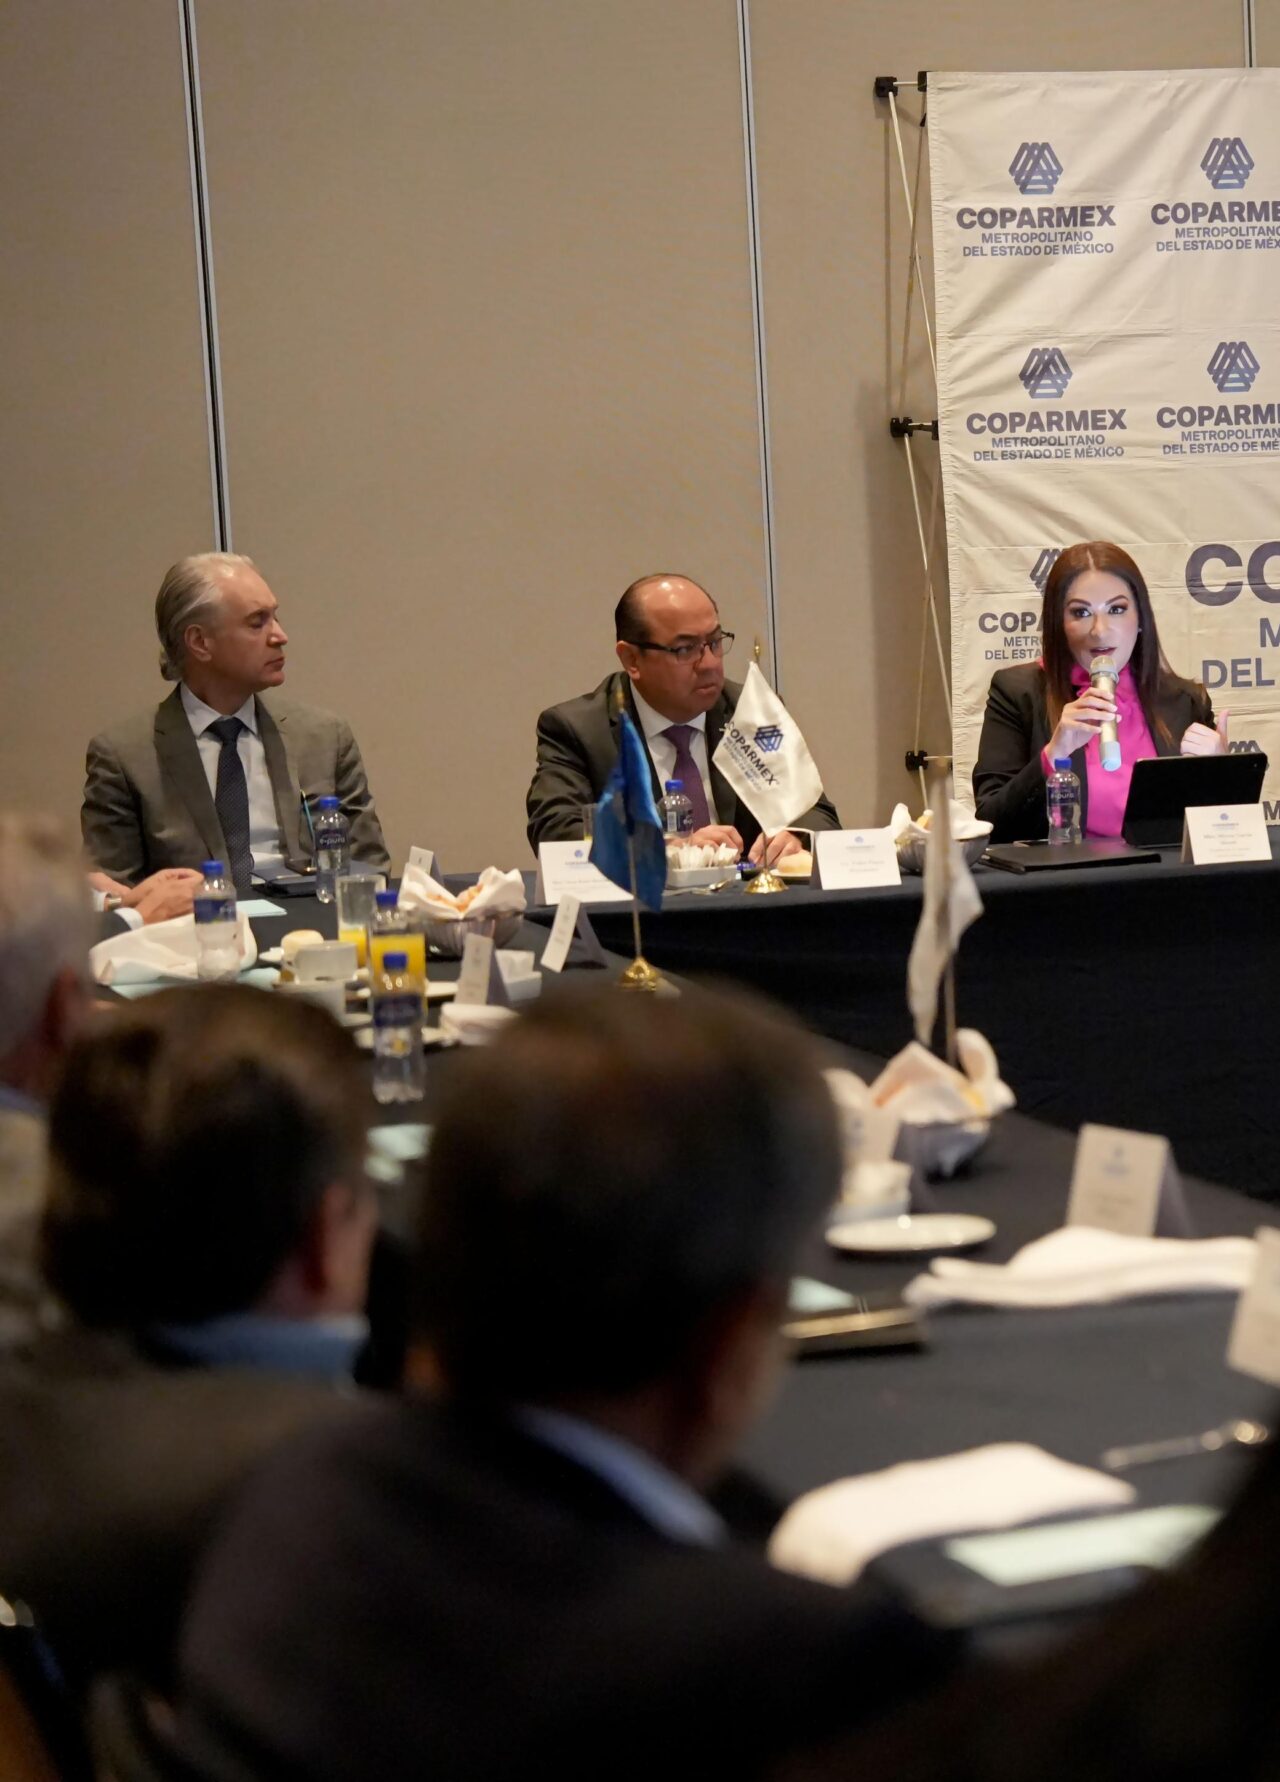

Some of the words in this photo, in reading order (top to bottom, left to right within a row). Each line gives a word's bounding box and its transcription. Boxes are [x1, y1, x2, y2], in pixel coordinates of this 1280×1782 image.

[956, 205, 1116, 229] COPARMEX
[981, 231, 1093, 244] METROPOLITANO
[963, 245, 988, 256] DEL
[990, 244, 1041, 256] ESTADO
[1044, 244, 1059, 255] DE
[1062, 242, 1114, 254] MÉXICO
[1156, 240, 1181, 251] DEL
[1183, 239, 1233, 251] ESTADO
[1236, 239, 1250, 250] DE
[966, 409, 1127, 434] COPARMEX
[991, 435, 1105, 448] METROPOLITANO
[1163, 443, 1187, 455] DEL
[1190, 442, 1239, 454] ESTADO
[1241, 441, 1257, 452] DE
[973, 449, 998, 462] DEL
[1000, 448, 1053, 460] ESTADO
[1056, 448, 1070, 458] DE
[1073, 445, 1124, 458] MÉXICO
[985, 650, 1009, 660] DEL
[1012, 648, 1042, 659] ESTA
[1202, 657, 1275, 689] DEL
